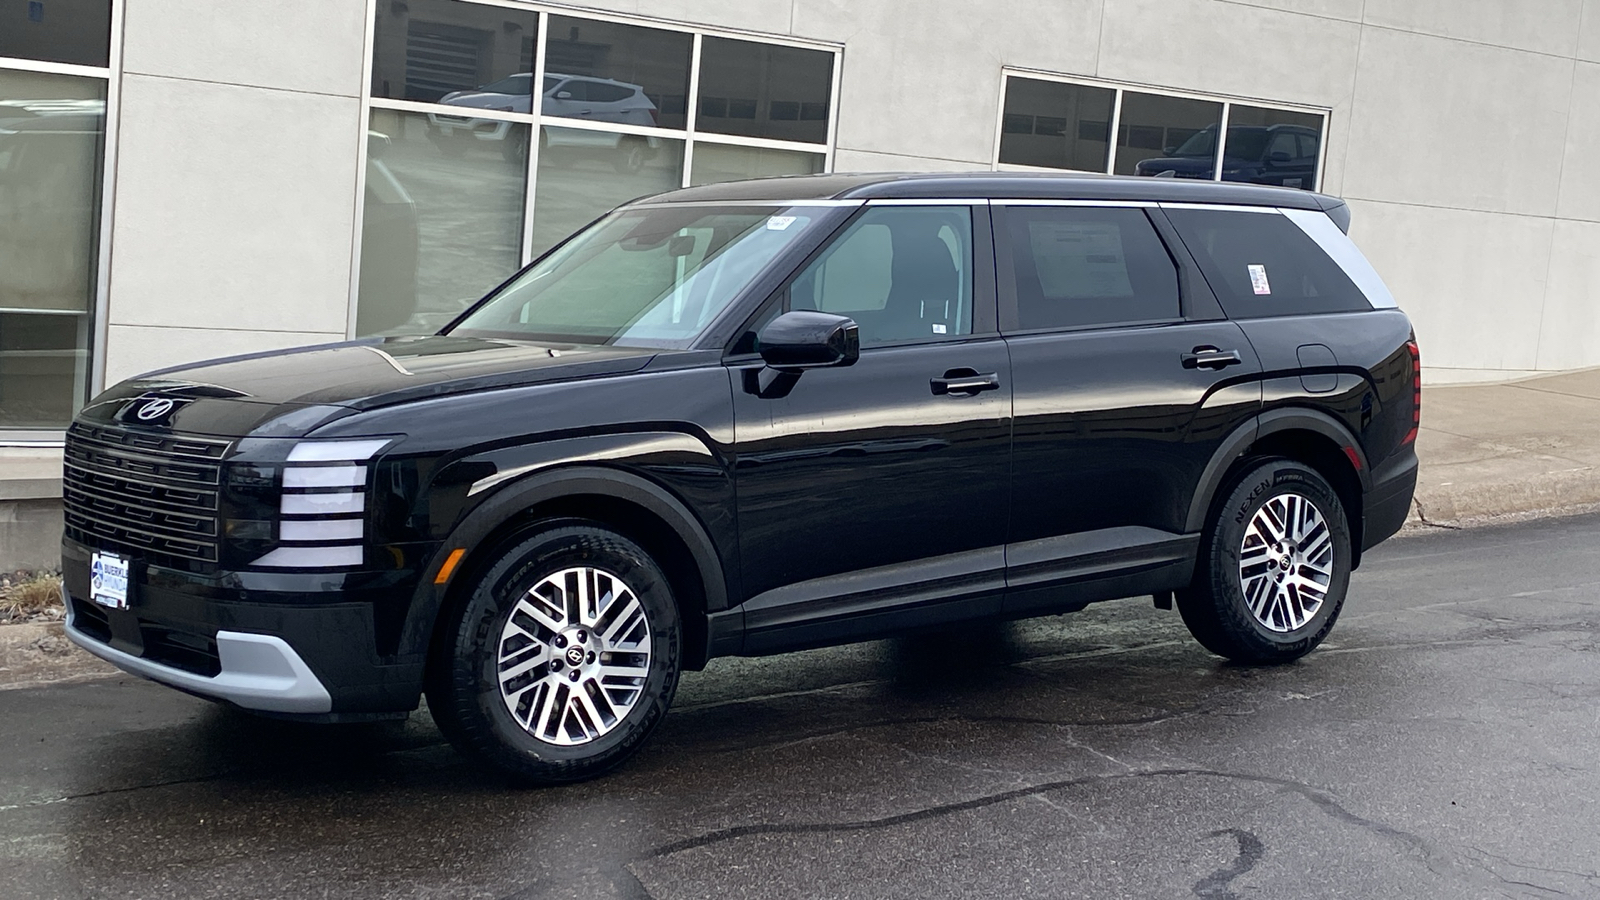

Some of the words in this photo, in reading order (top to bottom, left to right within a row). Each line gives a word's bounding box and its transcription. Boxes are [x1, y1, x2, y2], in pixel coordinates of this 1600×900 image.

[1235, 479, 1271, 524] NEXEN
[1310, 600, 1342, 644] NEXEN
[660, 626, 678, 700] NEXEN
